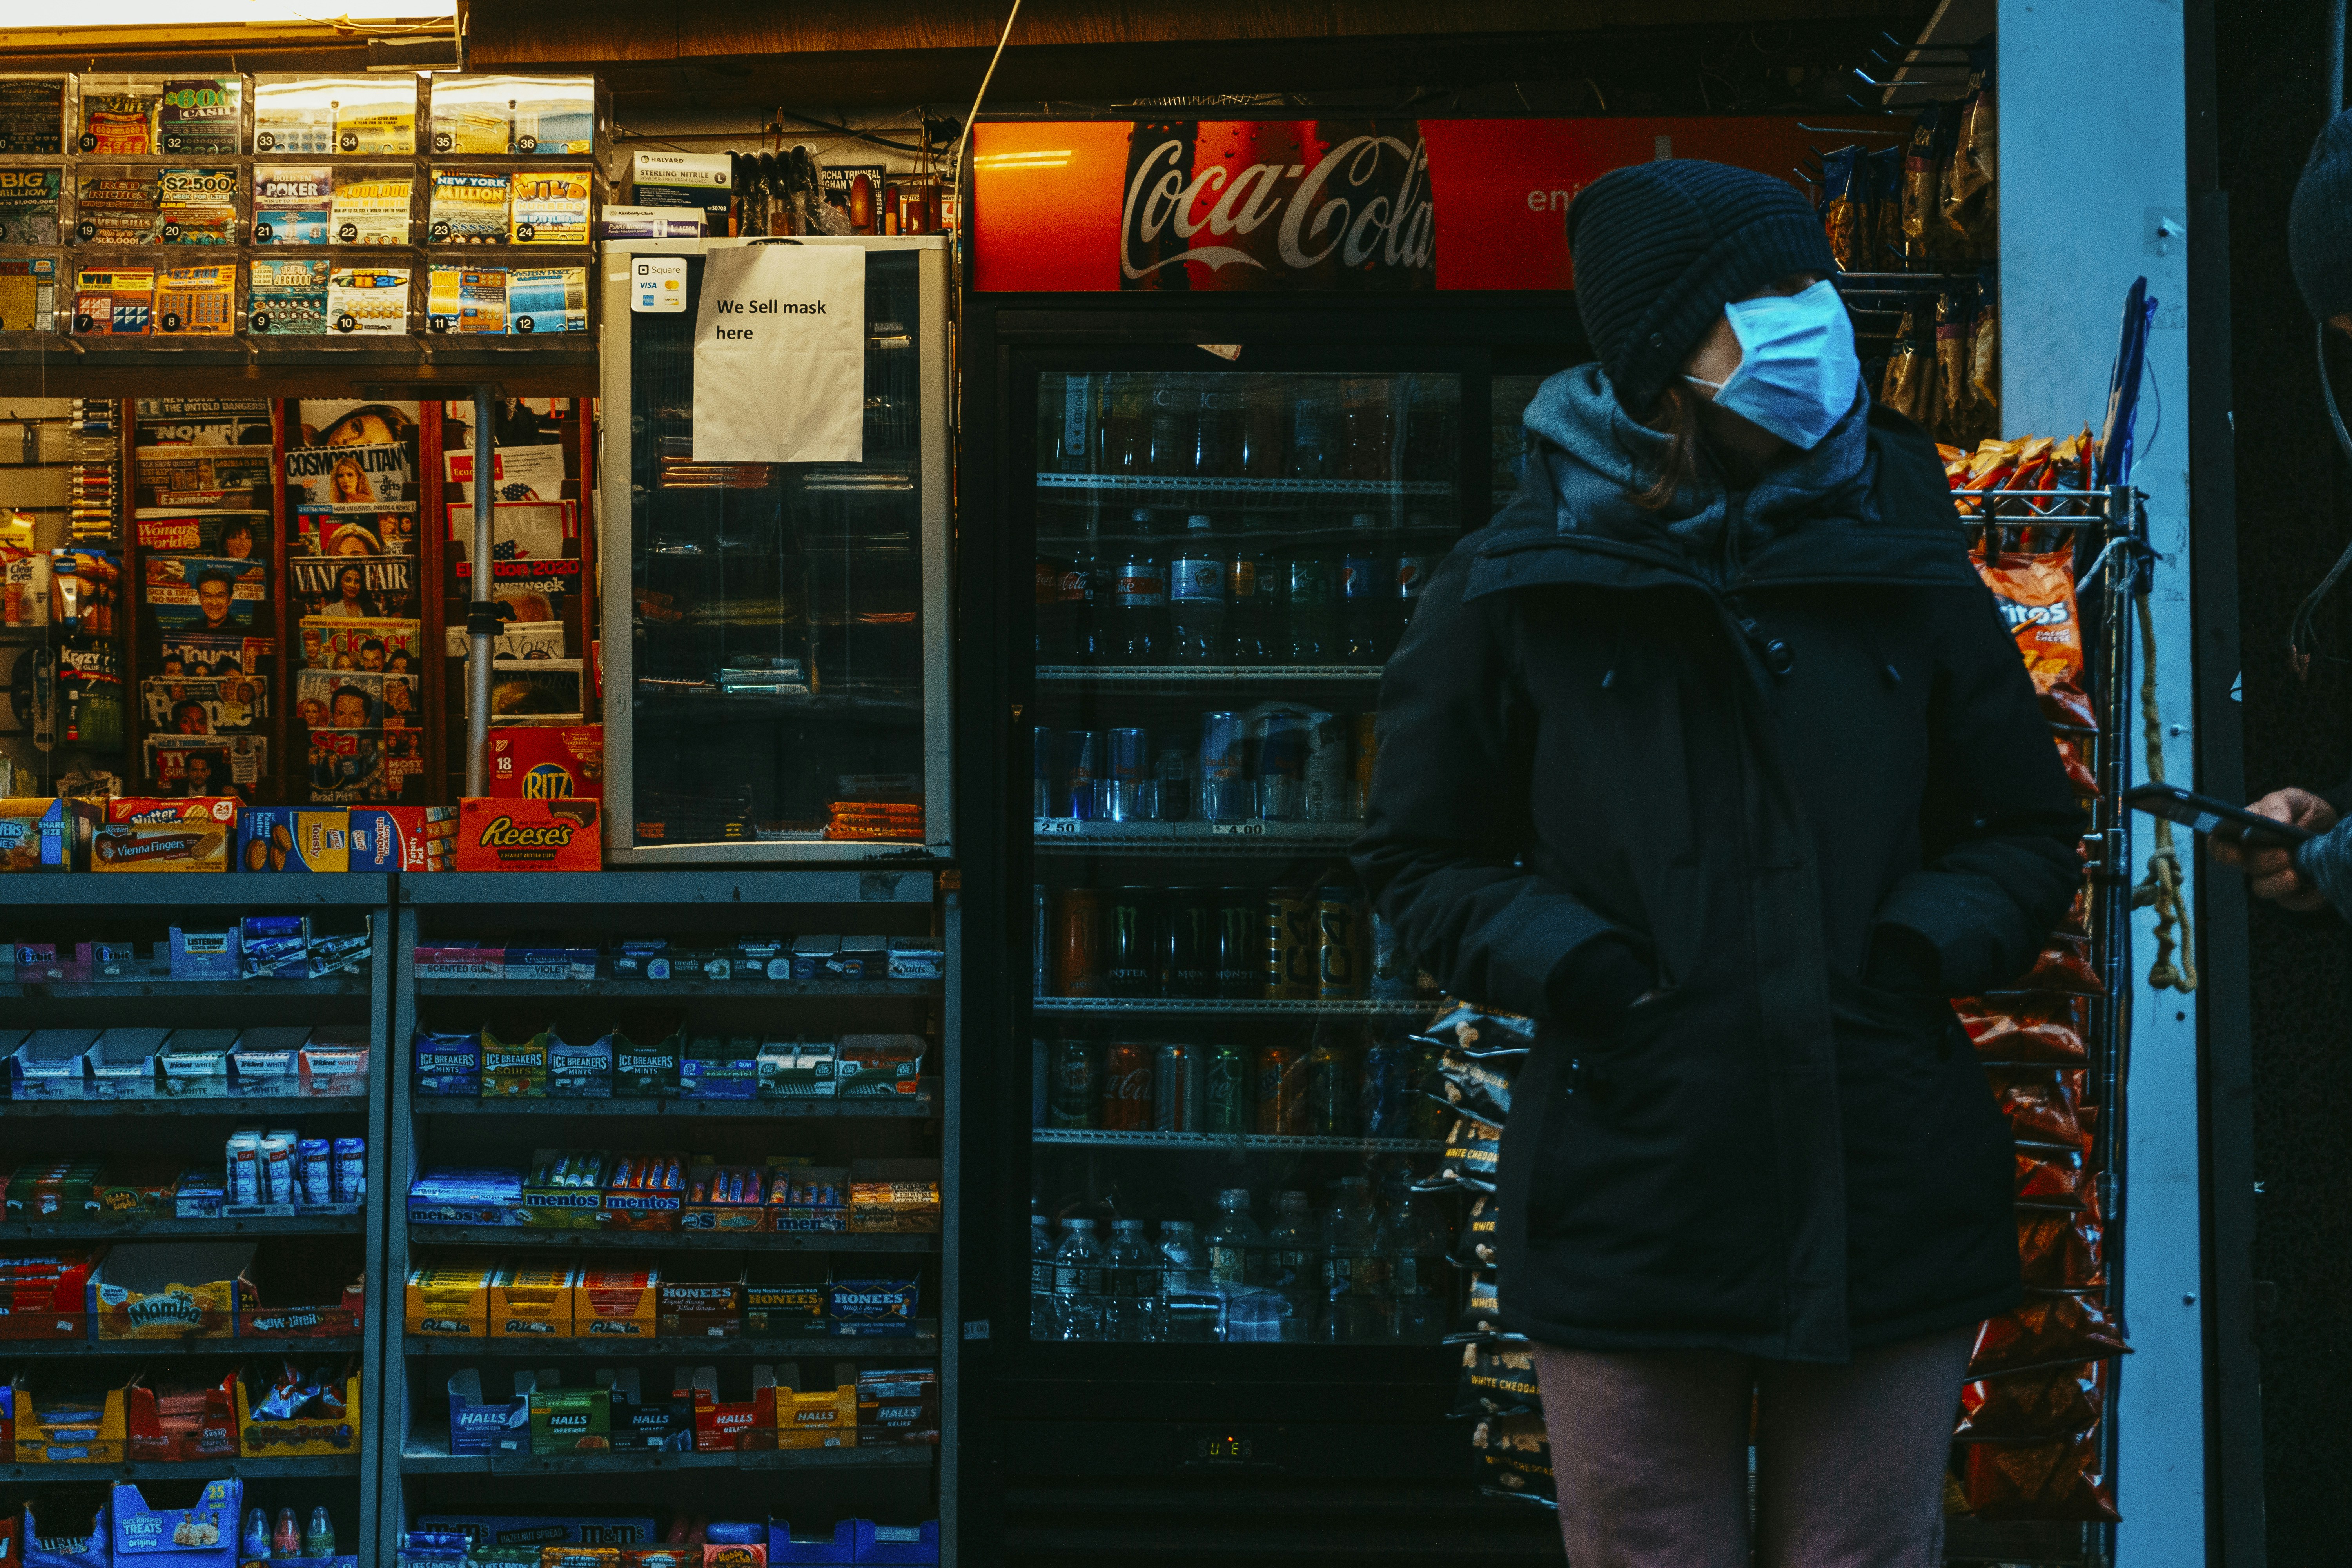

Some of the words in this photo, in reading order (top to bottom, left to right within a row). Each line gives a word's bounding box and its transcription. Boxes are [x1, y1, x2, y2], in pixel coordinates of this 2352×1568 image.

[183, 108, 230, 118] CASH
[83, 138, 94, 147] 31
[168, 139, 181, 147] 32
[260, 137, 272, 145] 33
[343, 137, 356, 146] 34
[437, 137, 450, 146] 35
[521, 140, 534, 149] 36
[1, 172, 44, 188] BIG
[165, 176, 231, 191] $2,500
[437, 177, 468, 186] NEW
[470, 177, 506, 187] YORK
[101, 181, 140, 190] RED
[267, 183, 318, 196] POKER
[515, 181, 587, 200] WILD
[89, 190, 148, 200] RICHES
[437, 187, 505, 200] MILLION
[1528, 183, 1579, 211] en
[517, 201, 583, 212] NUMBERS
[1120, 136, 1436, 279] Coca-Cola
[121, 218, 152, 228] BILLS
[82, 227, 92, 235] 19
[166, 227, 179, 235] 20
[342, 227, 355, 236] 22
[435, 226, 448, 234] 23
[519, 227, 532, 237] 24
[281, 265, 307, 274] TRIPLE
[652, 266, 680, 275] Square
[275, 275, 311, 285] JACKPOT
[432, 272, 458, 286] LOOSE
[432, 288, 459, 299] CHANGE
[717, 299, 744, 314] We
[749, 299, 777, 314] Sell
[784, 300, 826, 314] mask
[82, 318, 87, 326] 7
[168, 318, 174, 326] 8
[258, 316, 265, 325] 9
[341, 318, 352, 327] 10
[436, 319, 444, 328] 11
[520, 319, 530, 328] 12
[717, 326, 753, 339] here
[185, 403, 220, 411] UNTOLD
[138, 522, 198, 536] Woman's
[139, 535, 182, 548] World
[11, 565, 34, 574] Clear
[533, 561, 579, 575] 2020
[11, 573, 32, 582] eyes
[365, 564, 408, 590] FAIR
[497, 757, 512, 770] 18
[527, 772, 569, 799] RITZ
[481, 817, 572, 845] Reese's
[312, 822, 322, 858] Toasty
[375, 817, 384, 864] Sandwich
[117, 844, 150, 857] Vienna
[151, 840, 185, 852] Fingers
[408, 837, 417, 864] Variety
[420, 1054, 433, 1065] ICE
[434, 1054, 474, 1067] BREAKERS
[486, 1053, 499, 1065] ICE
[501, 1053, 542, 1066] BREAKERS
[553, 1056, 565, 1067] ICE
[566, 1056, 606, 1069] BREAKERS
[619, 1054, 631, 1066] ICE
[633, 1056, 673, 1069] BREAKERS
[526, 1194, 599, 1207] mentos
[606, 1195, 679, 1209] mentos
[663, 1287, 731, 1297] HONEES
[748, 1294, 818, 1304] HONEES
[834, 1294, 903, 1304] HONEES
[1471, 1374, 1498, 1386] WHITE
[797, 1411, 834, 1421] HALLS
[879, 1408, 916, 1417] HALLS
[460, 1413, 506, 1425] HALLS
[551, 1416, 588, 1425] HALLS
[632, 1415, 669, 1424] HALLS
[716, 1414, 753, 1424] HALLS
[209, 1485, 225, 1499] 25
[124, 1524, 162, 1535] TREATS
[500, 1532, 534, 1543] HAZELNUT
[536, 1528, 563, 1540] SPREAD
[128, 1539, 156, 1548] original
